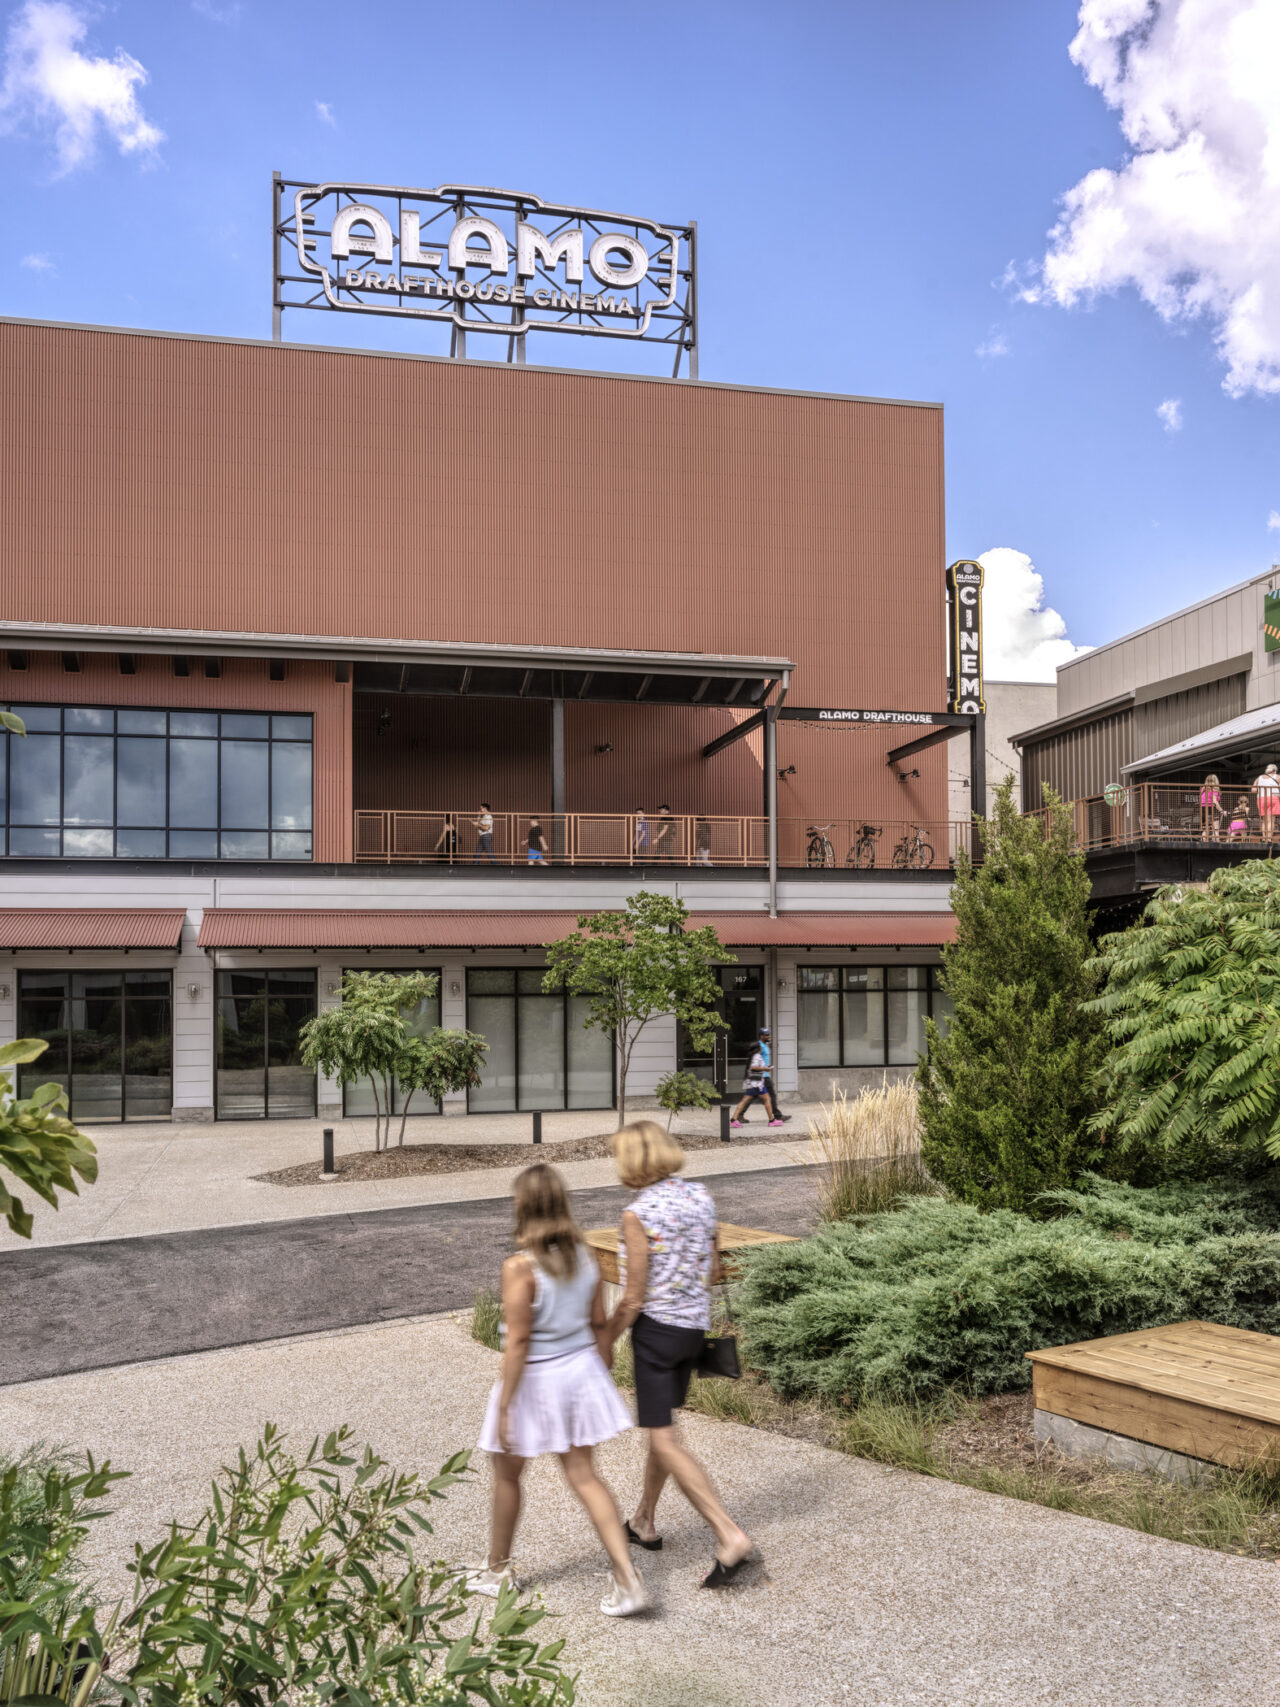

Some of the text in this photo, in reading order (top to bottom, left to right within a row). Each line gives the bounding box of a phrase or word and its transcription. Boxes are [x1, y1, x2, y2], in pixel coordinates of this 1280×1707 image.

[331, 203, 649, 288] ALAMO
[346, 268, 635, 315] DRAFTHOUSE CINEMA
[819, 710, 932, 723] ALAMO DRAFTHOUSE
